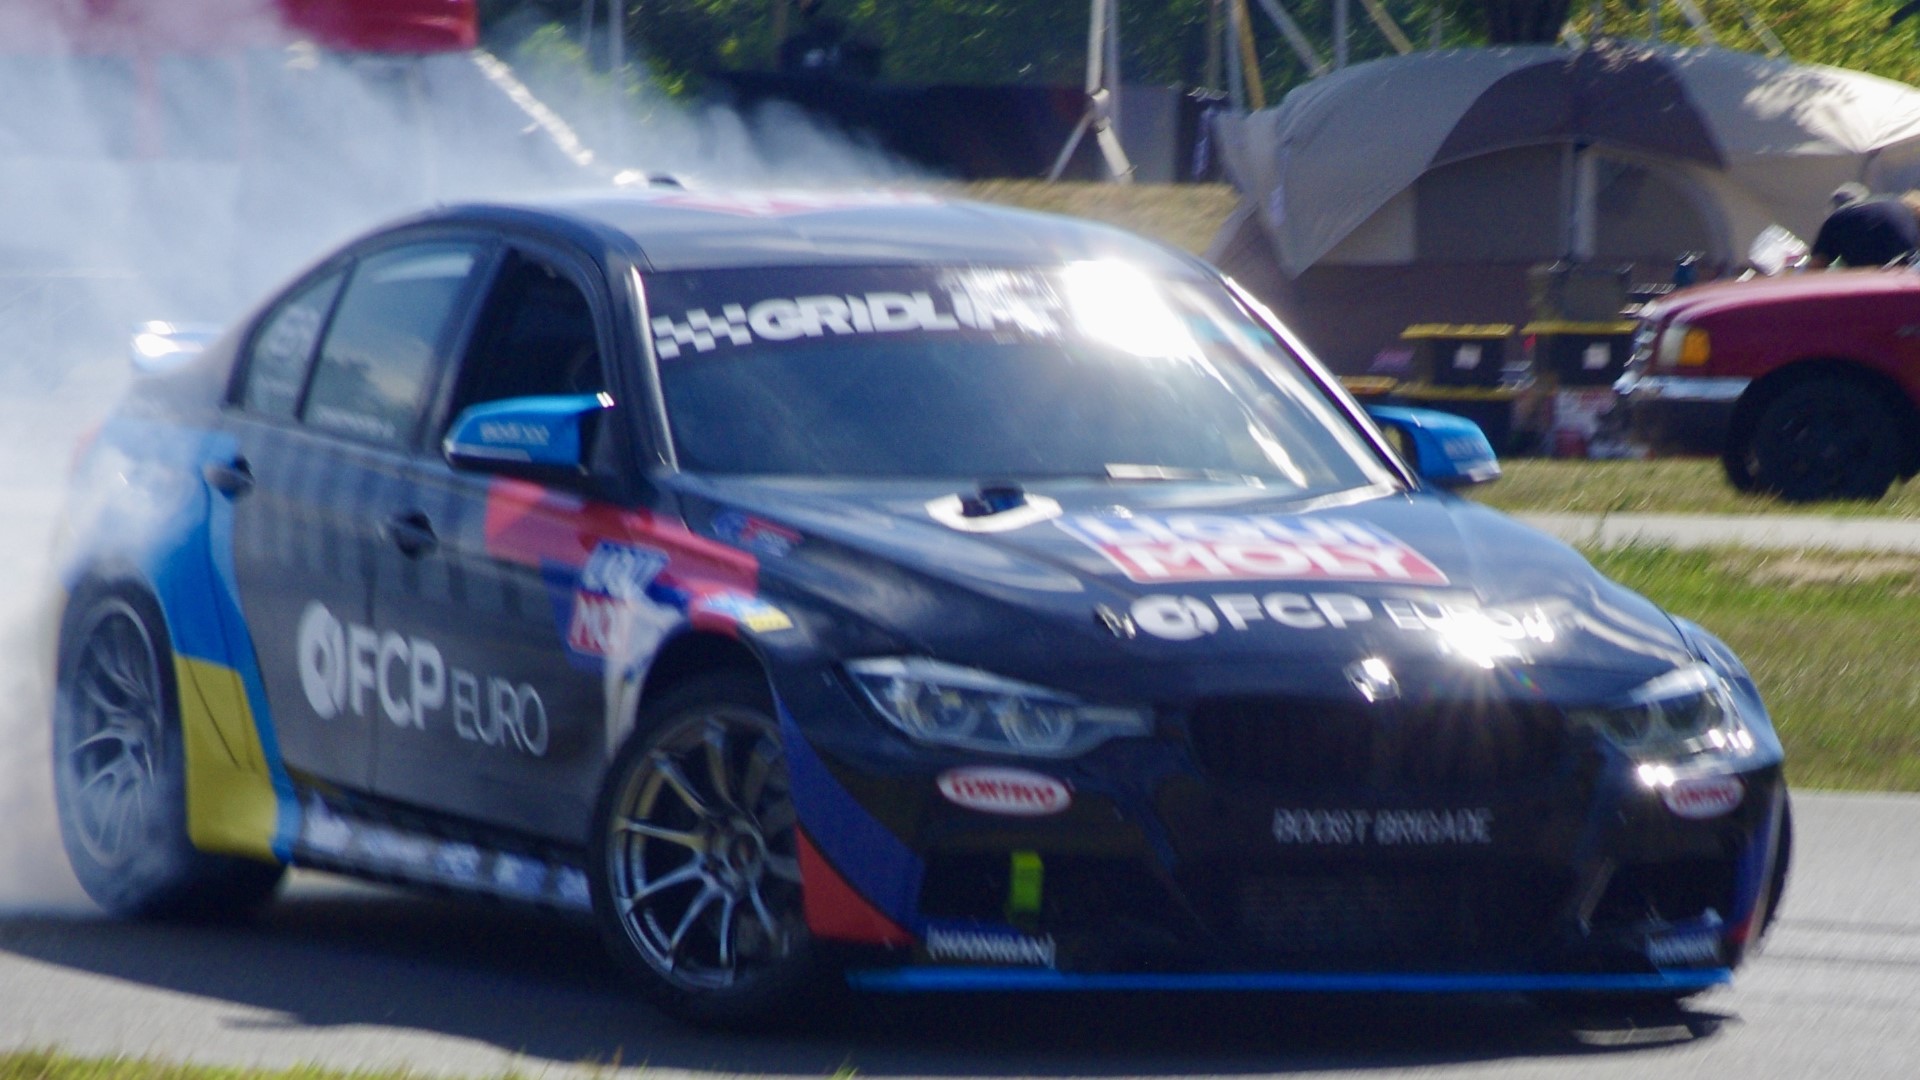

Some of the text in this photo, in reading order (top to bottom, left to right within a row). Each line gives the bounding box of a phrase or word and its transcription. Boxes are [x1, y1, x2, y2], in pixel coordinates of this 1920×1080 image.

[1118, 543, 1412, 578] MOLY
[1211, 592, 1373, 631] FCP
[348, 620, 549, 757] FCP EURO
[1272, 807, 1495, 844] BOOST BRIGADE
